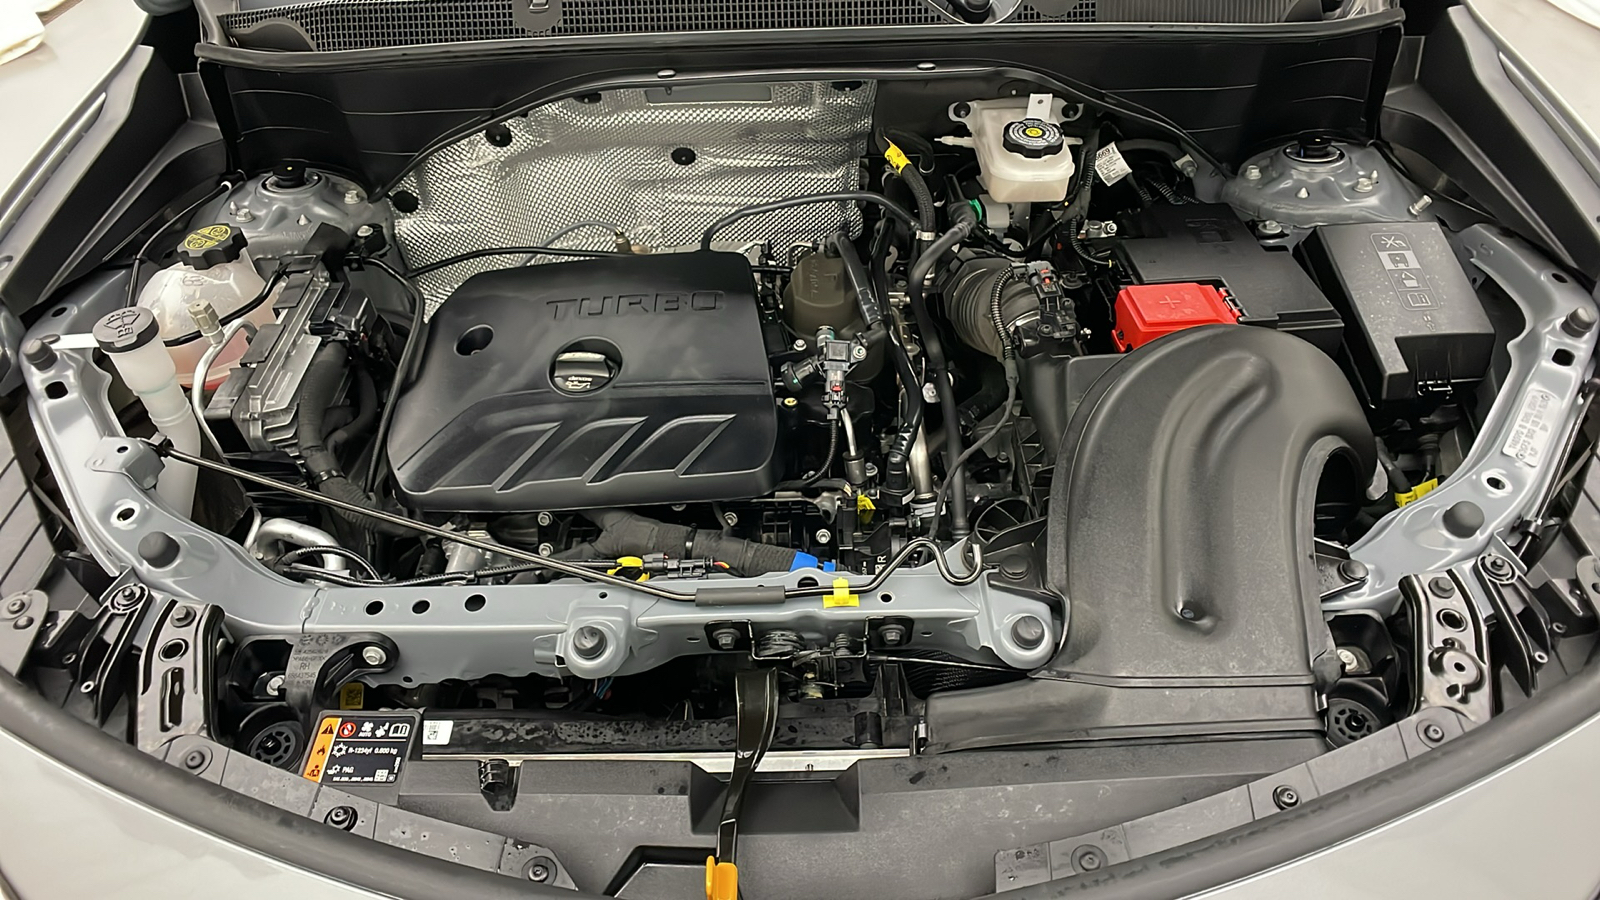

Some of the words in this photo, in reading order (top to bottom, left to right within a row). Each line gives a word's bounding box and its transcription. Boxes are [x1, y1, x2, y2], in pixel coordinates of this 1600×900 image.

[546, 291, 726, 320] TURBO
[300, 662, 310, 670] RH
[348, 747, 373, 755] R-1234yf
[390, 747, 398, 755] kg
[342, 766, 355, 774] PAG
